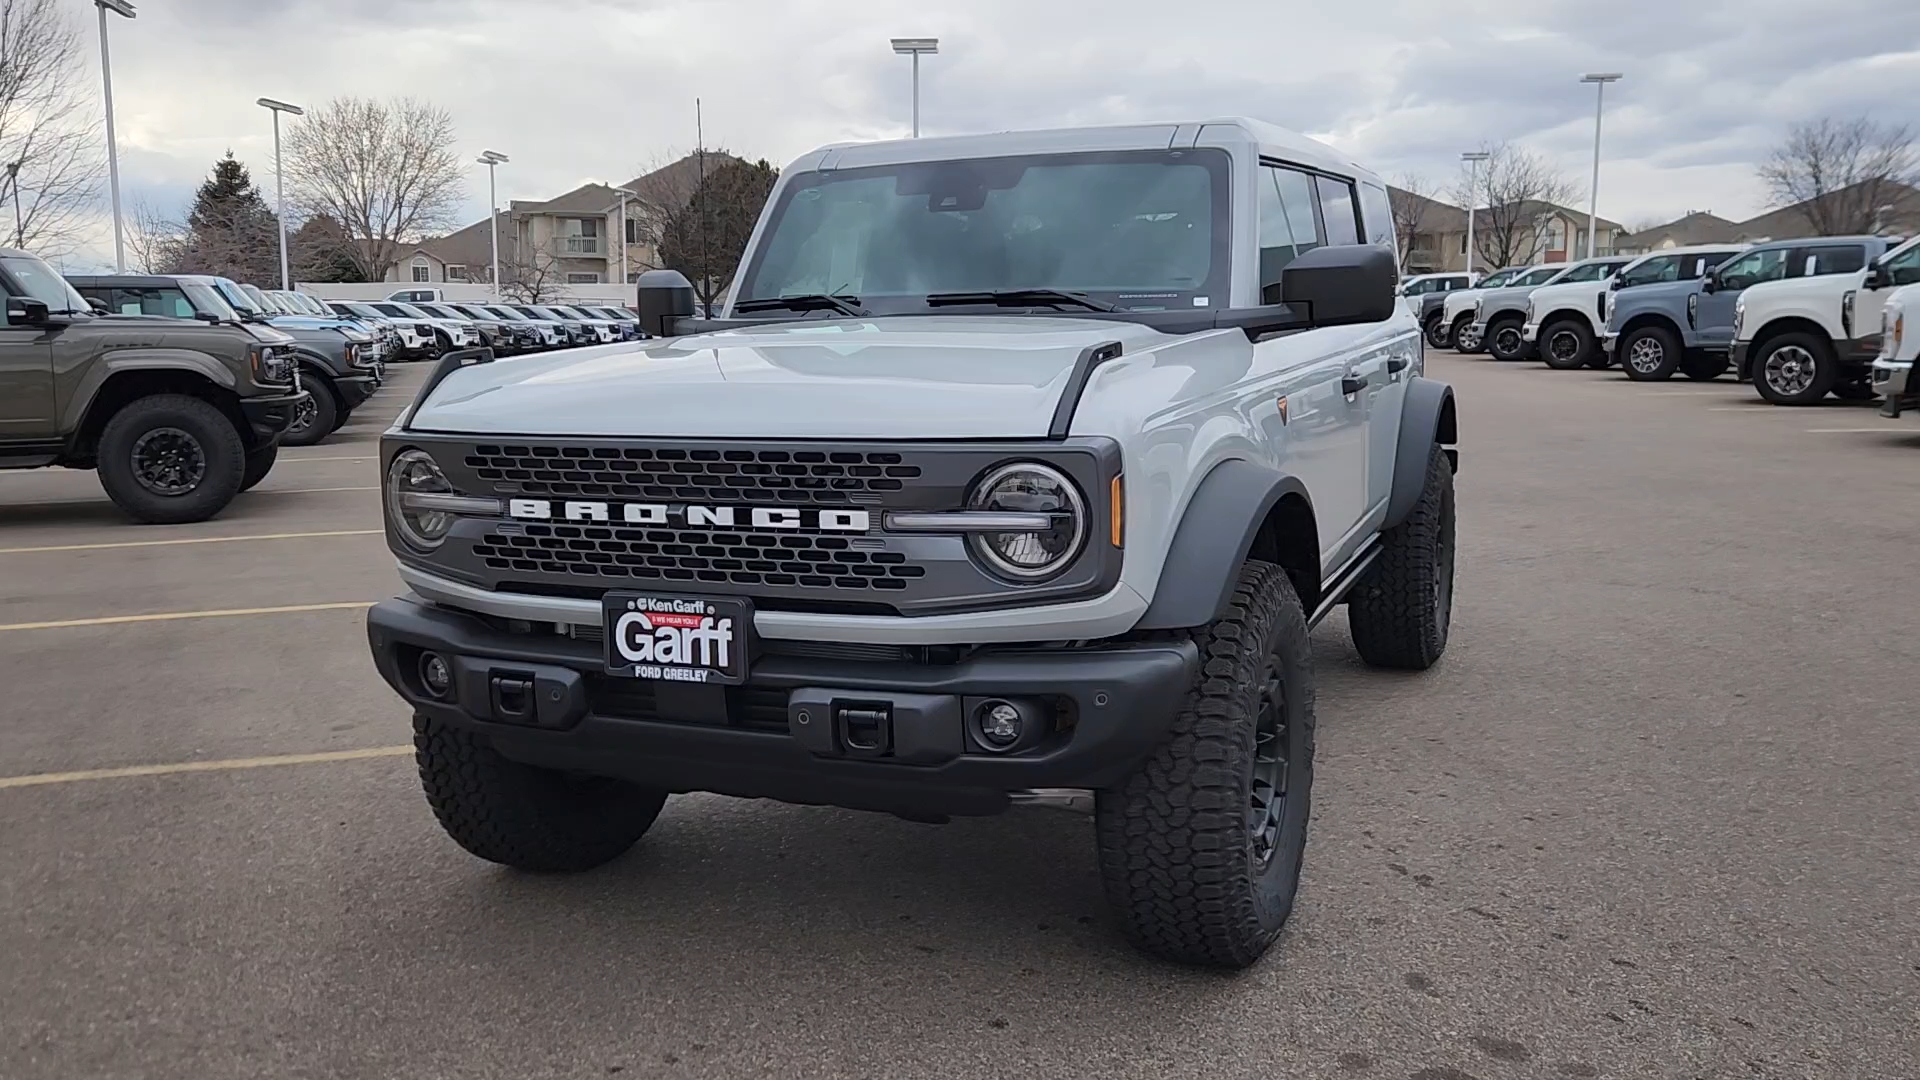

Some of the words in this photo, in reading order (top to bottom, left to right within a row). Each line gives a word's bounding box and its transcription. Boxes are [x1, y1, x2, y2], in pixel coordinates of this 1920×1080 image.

[510, 498, 870, 530] BRONCO
[648, 598, 673, 612] Ken
[673, 600, 704, 614] Garff
[666, 616, 682, 624] HEAR
[616, 611, 732, 667] Garff
[635, 666, 661, 679] FORD
[663, 668, 708, 682] GREELEY
